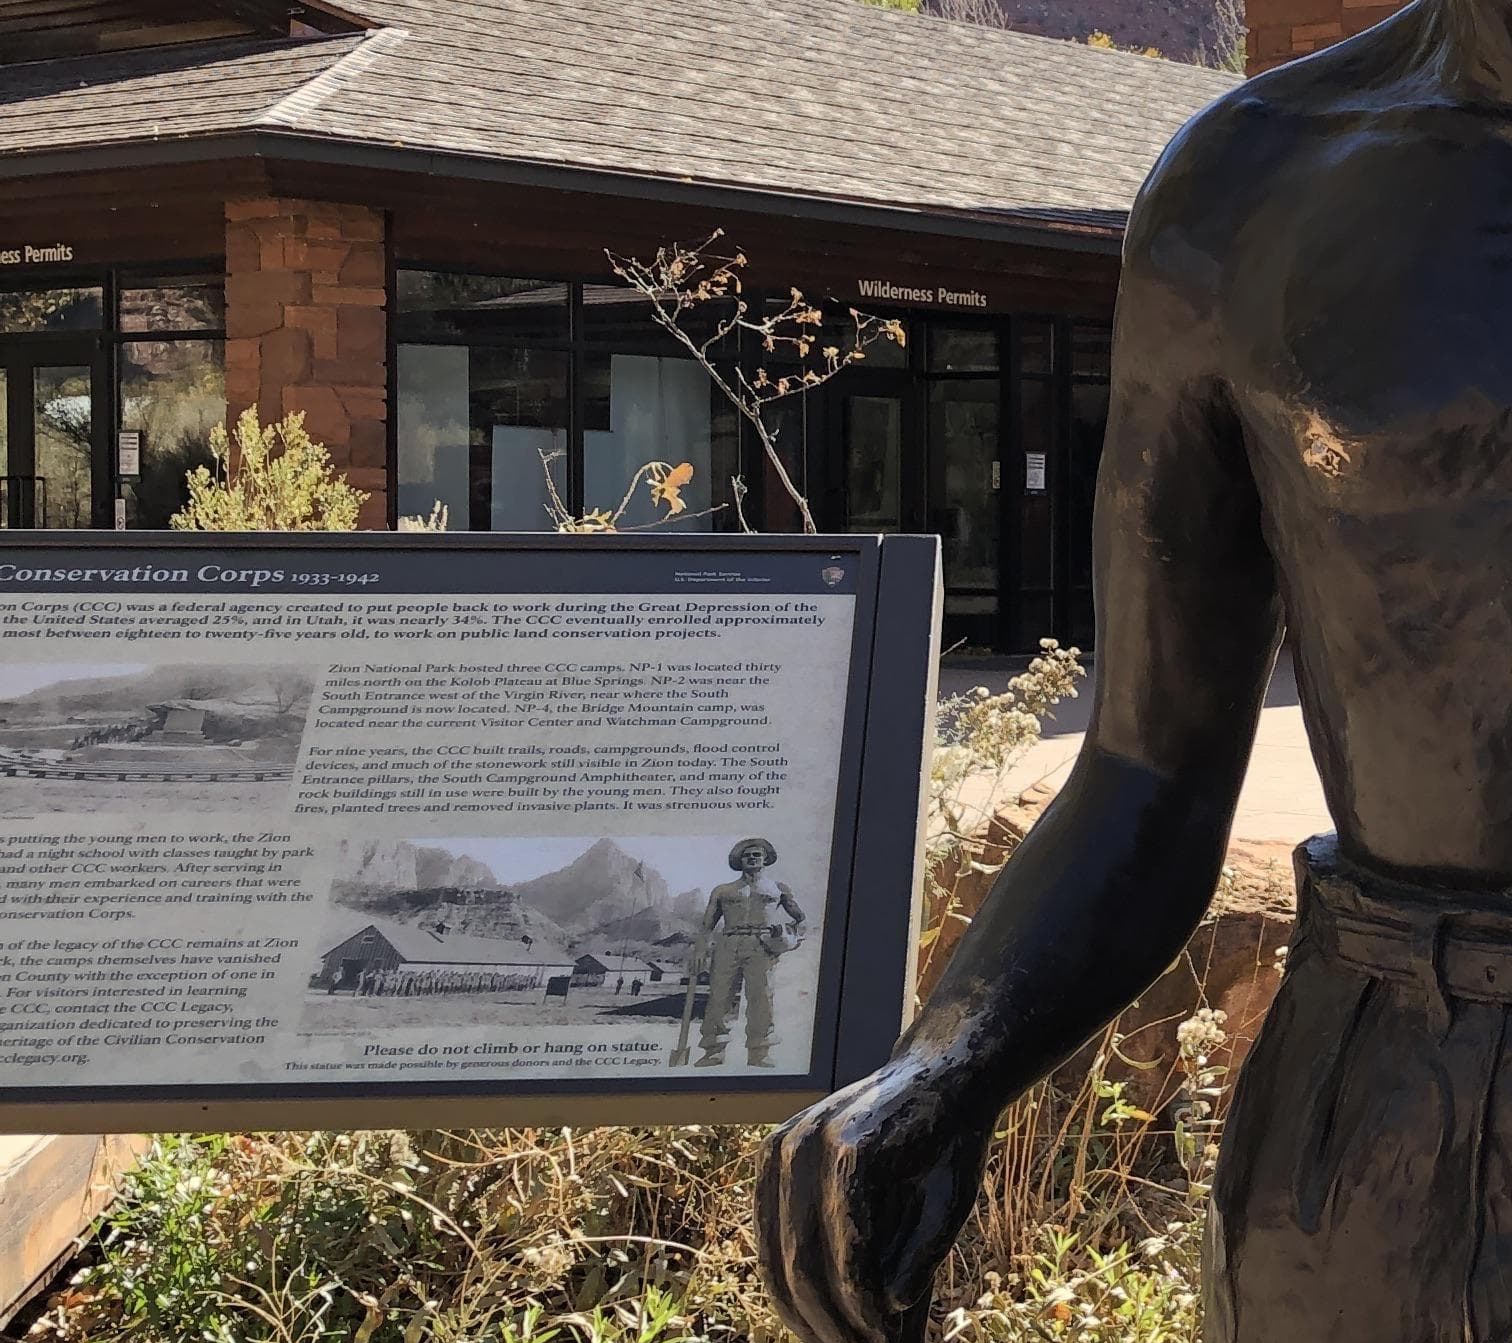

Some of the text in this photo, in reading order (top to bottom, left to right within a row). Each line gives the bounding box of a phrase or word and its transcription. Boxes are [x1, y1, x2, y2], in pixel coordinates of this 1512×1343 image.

[24, 243, 73, 263] Permits
[858, 279, 987, 307] Wilderness Permits
[0, 564, 379, 586] Conservation Corps 1933-1942
[21, 601, 69, 614] Corps
[72, 601, 121, 613] (CCC)
[170, 601, 226, 612] federal
[228, 604, 282, 614] agency
[285, 602, 344, 612] created
[347, 603, 363, 612] to
[365, 603, 392, 614] put
[395, 602, 448, 614] people
[452, 602, 488, 612] back
[493, 603, 508, 612] to
[512, 602, 551, 611] work
[554, 602, 607, 614] during
[610, 602, 634, 612] the
[638, 602, 681, 611] Great
[684, 602, 770, 615] Depression
[774, 601, 791, 612] of
[794, 602, 817, 611] the
[2, 614, 825, 627] the United States averaged 25%, and in Utah, it was nearly 34%. The CCC eventually enrolled approximately
[2, 629, 41, 638] most
[45, 627, 111, 638] between
[115, 628, 181, 641] eighteen
[185, 630, 201, 638] to
[205, 628, 292, 641] twenty-five
[294, 631, 336, 641] years
[340, 628, 369, 639] old,
[374, 630, 389, 638] to
[393, 628, 433, 638] work
[460, 628, 509, 641] public
[513, 628, 548, 638] land
[551, 627, 651, 638] conservation
[654, 627, 721, 640] projects.
[328, 663, 360, 673] Zion
[363, 663, 422, 673] National
[425, 663, 455, 673] Park
[458, 663, 503, 672] hosted
[506, 663, 541, 672] three
[544, 663, 577, 673] CCC
[628, 662, 661, 672] NP-1
[694, 662, 742, 671] located
[745, 662, 781, 673] thirty
[321, 691, 360, 700] South
[364, 691, 425, 700] Entrance
[428, 692, 458, 700] west
[461, 690, 477, 699] of
[479, 690, 500, 699] the
[504, 690, 544, 702] Virgin
[622, 689, 664, 698] where
[666, 689, 687, 698] the
[690, 688, 728, 698] South
[314, 718, 365, 728] located
[401, 718, 423, 727] the
[426, 719, 477, 727] current
[480, 717, 525, 727] Visitor
[527, 717, 574, 727] Center
[576, 716, 602, 726] and
[605, 716, 678, 726] Watchman
[308, 746, 333, 756] For
[335, 746, 366, 755] nine
[411, 745, 433, 755] the
[436, 745, 471, 755] CCC
[472, 745, 505, 754] built
[693, 743, 727, 753] flood
[731, 742, 779, 752] control
[5, 880, 46, 890] many
[48, 880, 81, 888] men
[83, 877, 156, 888] embarked
[158, 880, 179, 888] on
[180, 879, 232, 887] careers
[235, 877, 263, 887] that
[5, 985, 248, 998] For visitors interested in learning
[363, 1041, 662, 1056] Please do not climb or hang on statue.
